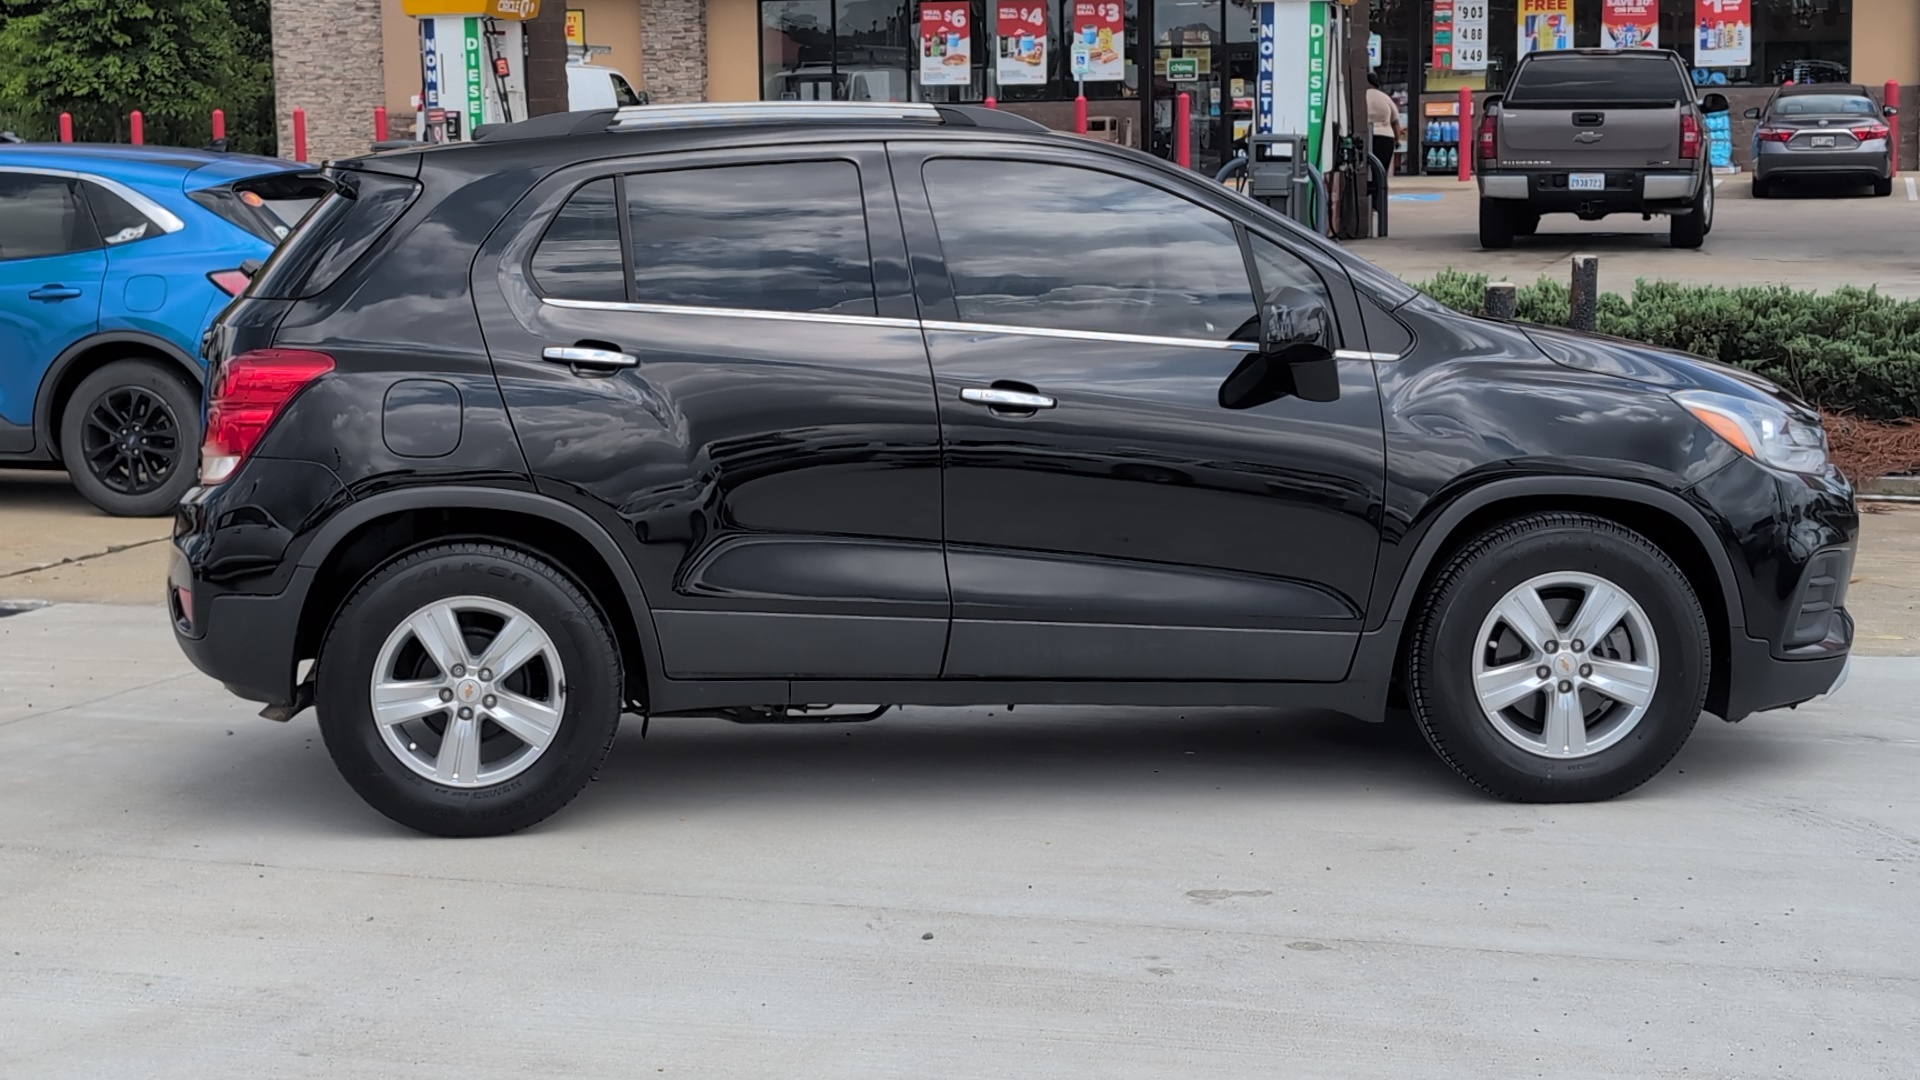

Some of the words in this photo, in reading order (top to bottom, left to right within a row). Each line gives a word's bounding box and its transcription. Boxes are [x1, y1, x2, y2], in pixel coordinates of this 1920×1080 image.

[1098, 3, 1120, 22] $3
[1524, 0, 1568, 11] FREE
[944, 9, 966, 28] $6
[1020, 7, 1043, 26] $4
[1310, 23, 1323, 124] DIESEL
